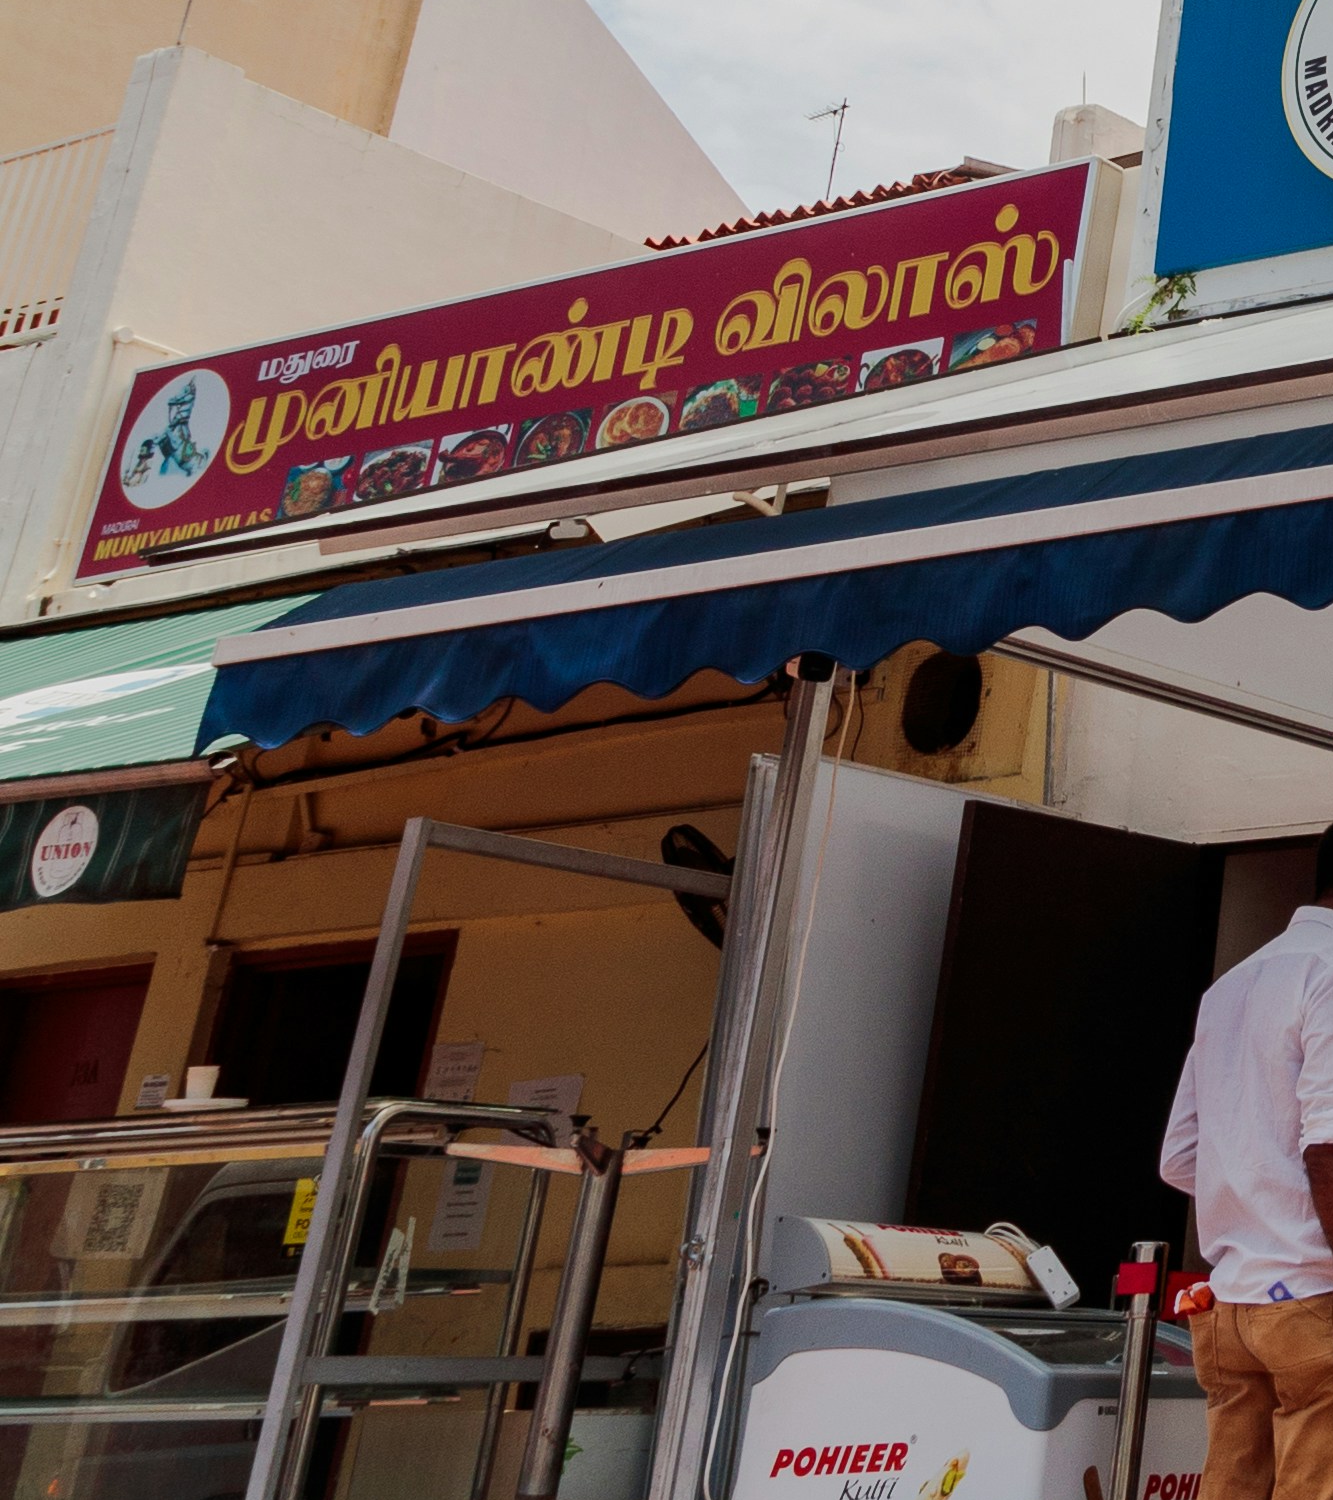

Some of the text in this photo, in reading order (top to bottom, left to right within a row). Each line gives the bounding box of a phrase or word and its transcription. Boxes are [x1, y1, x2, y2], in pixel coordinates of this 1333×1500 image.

[225, 203, 1060, 475] முனியாண்டி விலாஸ்
[257, 339, 361, 385] மதுரை
[101, 518, 141, 535] MADURAI
[40, 840, 94, 862] UNION
[769, 1442, 909, 1478] POHIEER
